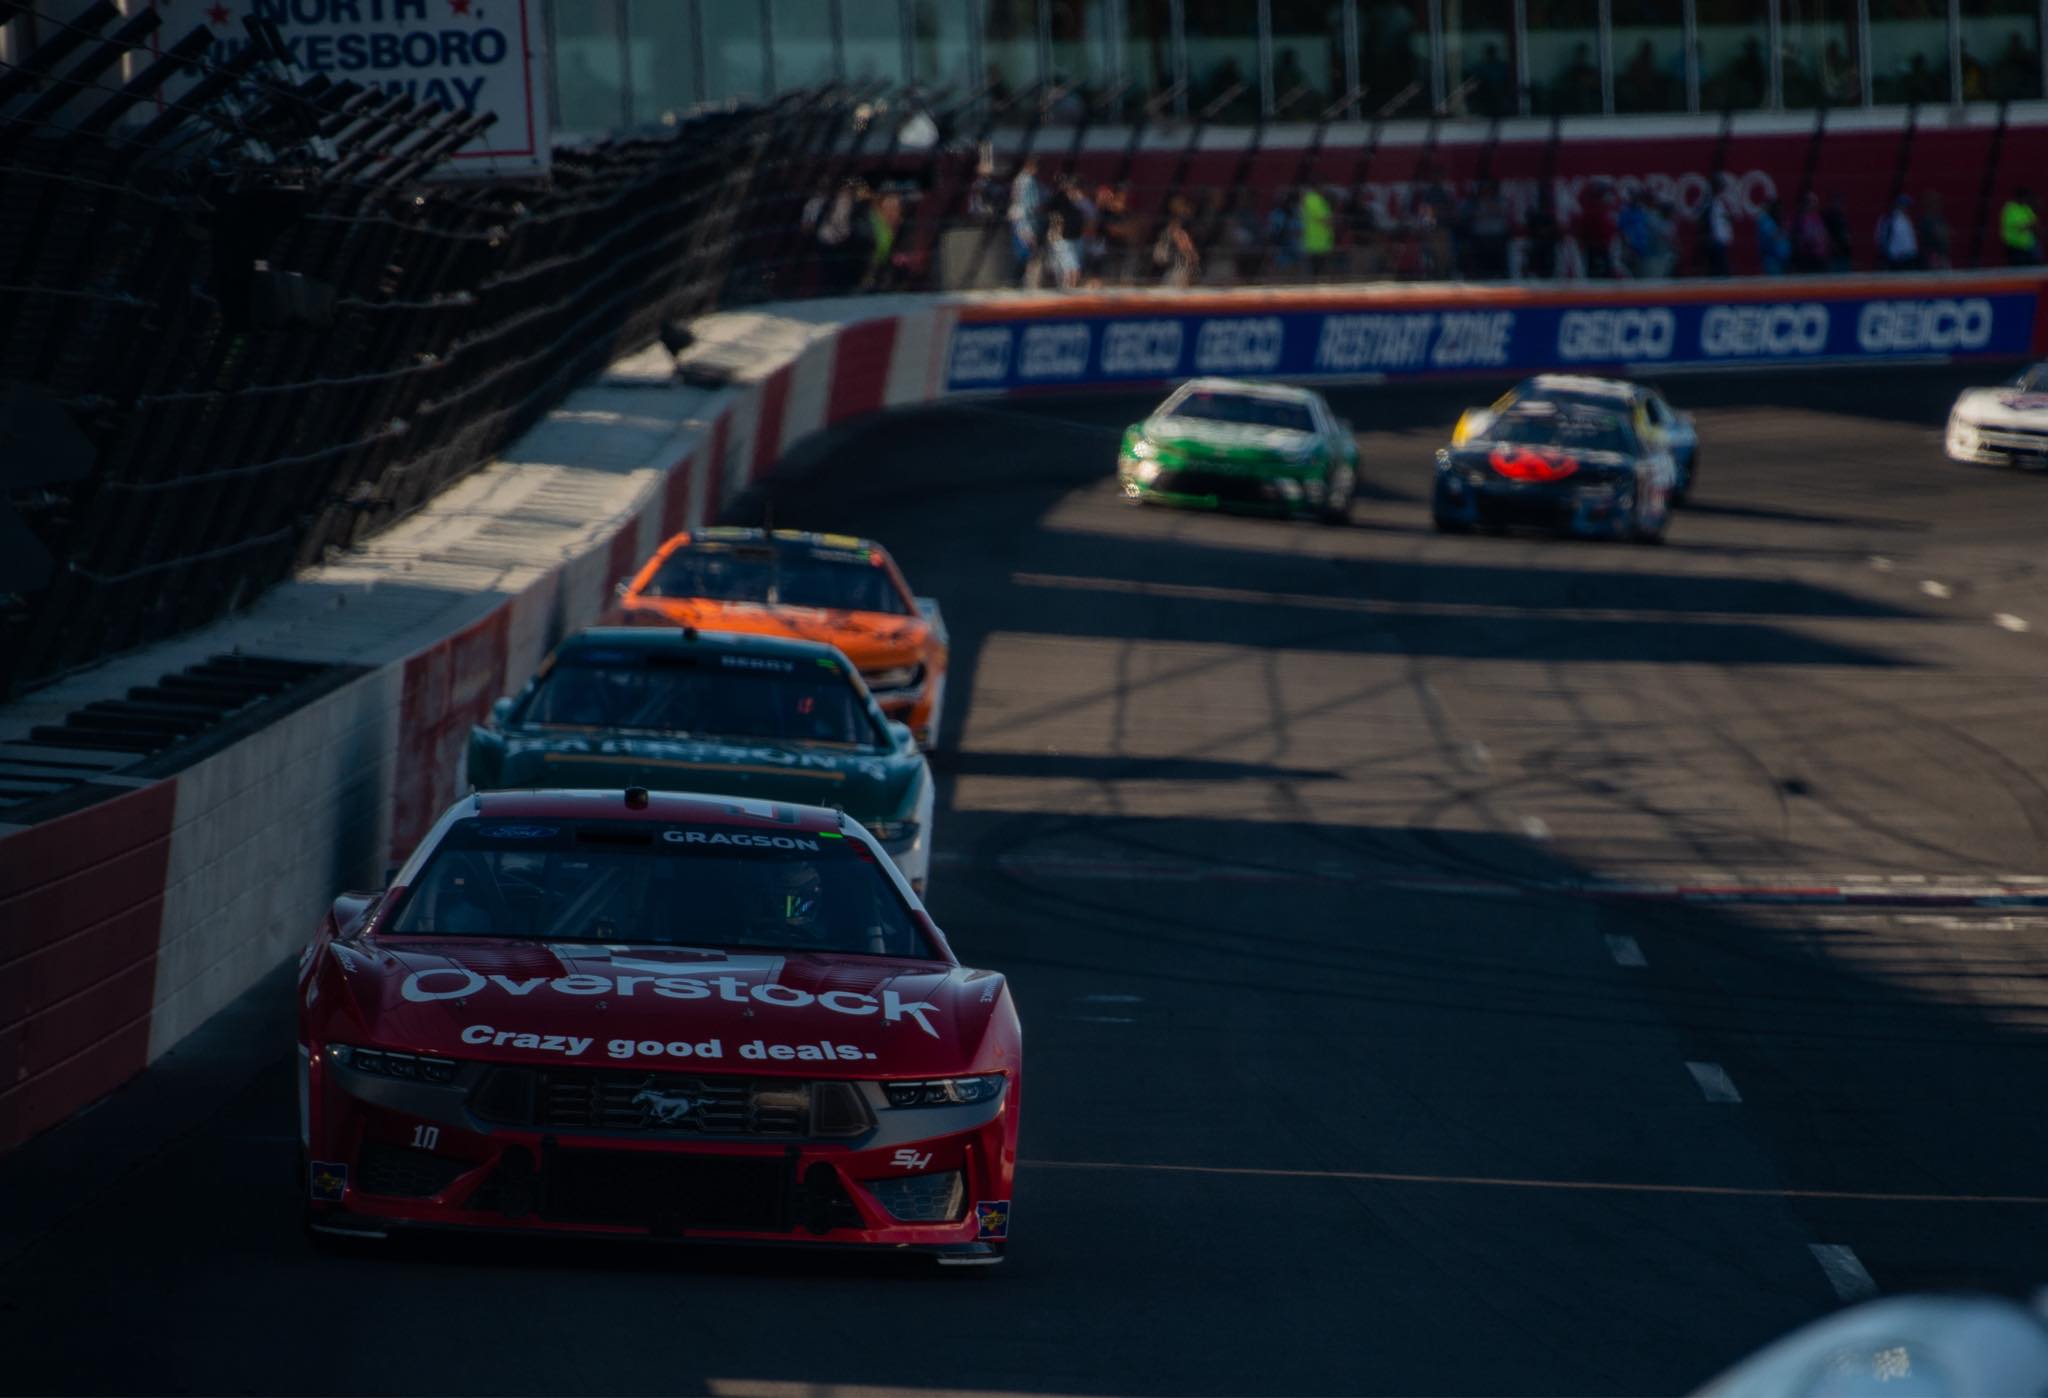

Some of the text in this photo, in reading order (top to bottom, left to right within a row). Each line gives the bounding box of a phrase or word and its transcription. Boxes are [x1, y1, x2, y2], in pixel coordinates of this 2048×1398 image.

[1557, 307, 1676, 361] GEICO
[1701, 302, 1831, 356] GEICO
[1856, 297, 1993, 352] GEICO
[663, 830, 820, 852] GRAGSON
[401, 968, 942, 1040] Overstock
[461, 1024, 878, 1061] Crazy good deals.
[410, 1124, 441, 1150] 10
